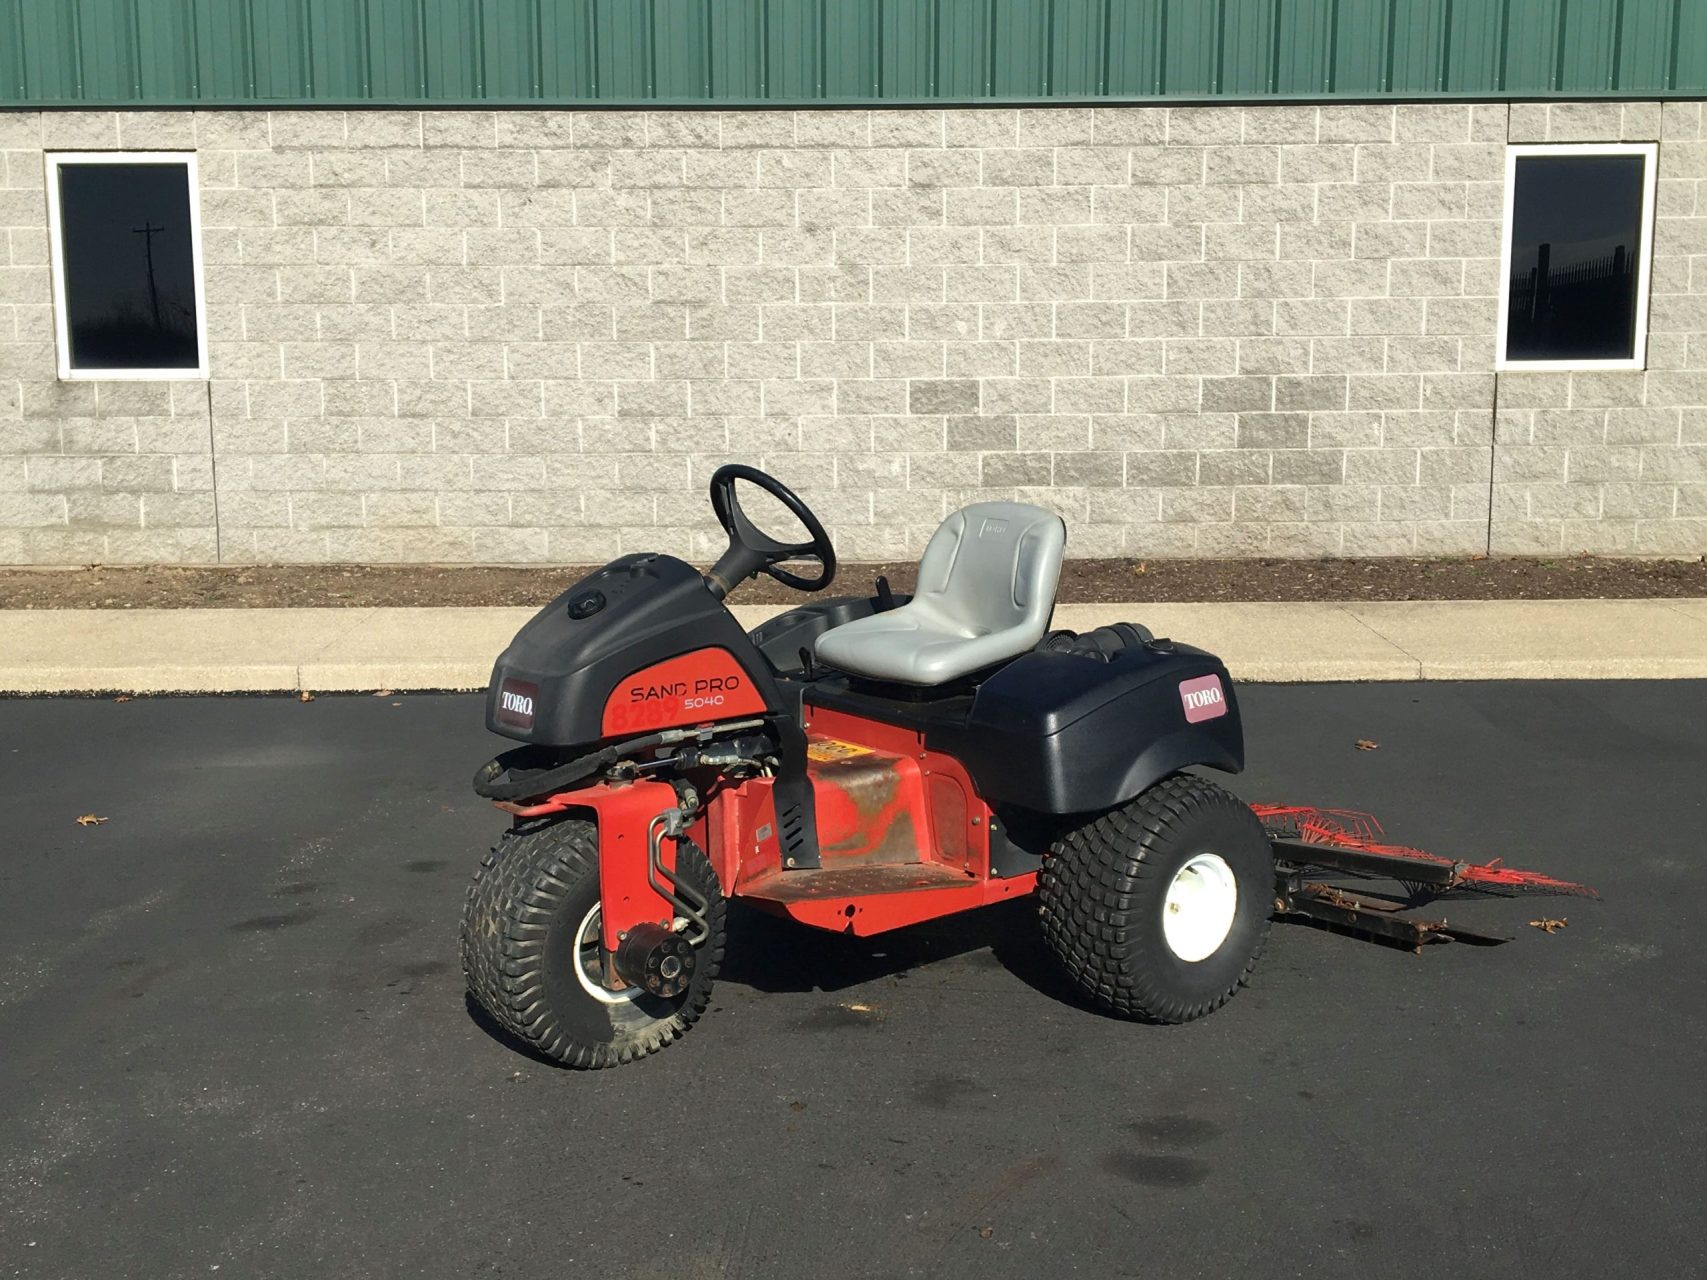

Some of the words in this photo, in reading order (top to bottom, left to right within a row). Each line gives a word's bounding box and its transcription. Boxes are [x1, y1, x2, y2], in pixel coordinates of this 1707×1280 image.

[630, 682, 687, 702] SAND
[695, 676, 740, 695] PRO
[1184, 687, 1221, 709] TORO
[502, 691, 532, 715] TORO
[684, 695, 724, 709] 5040
